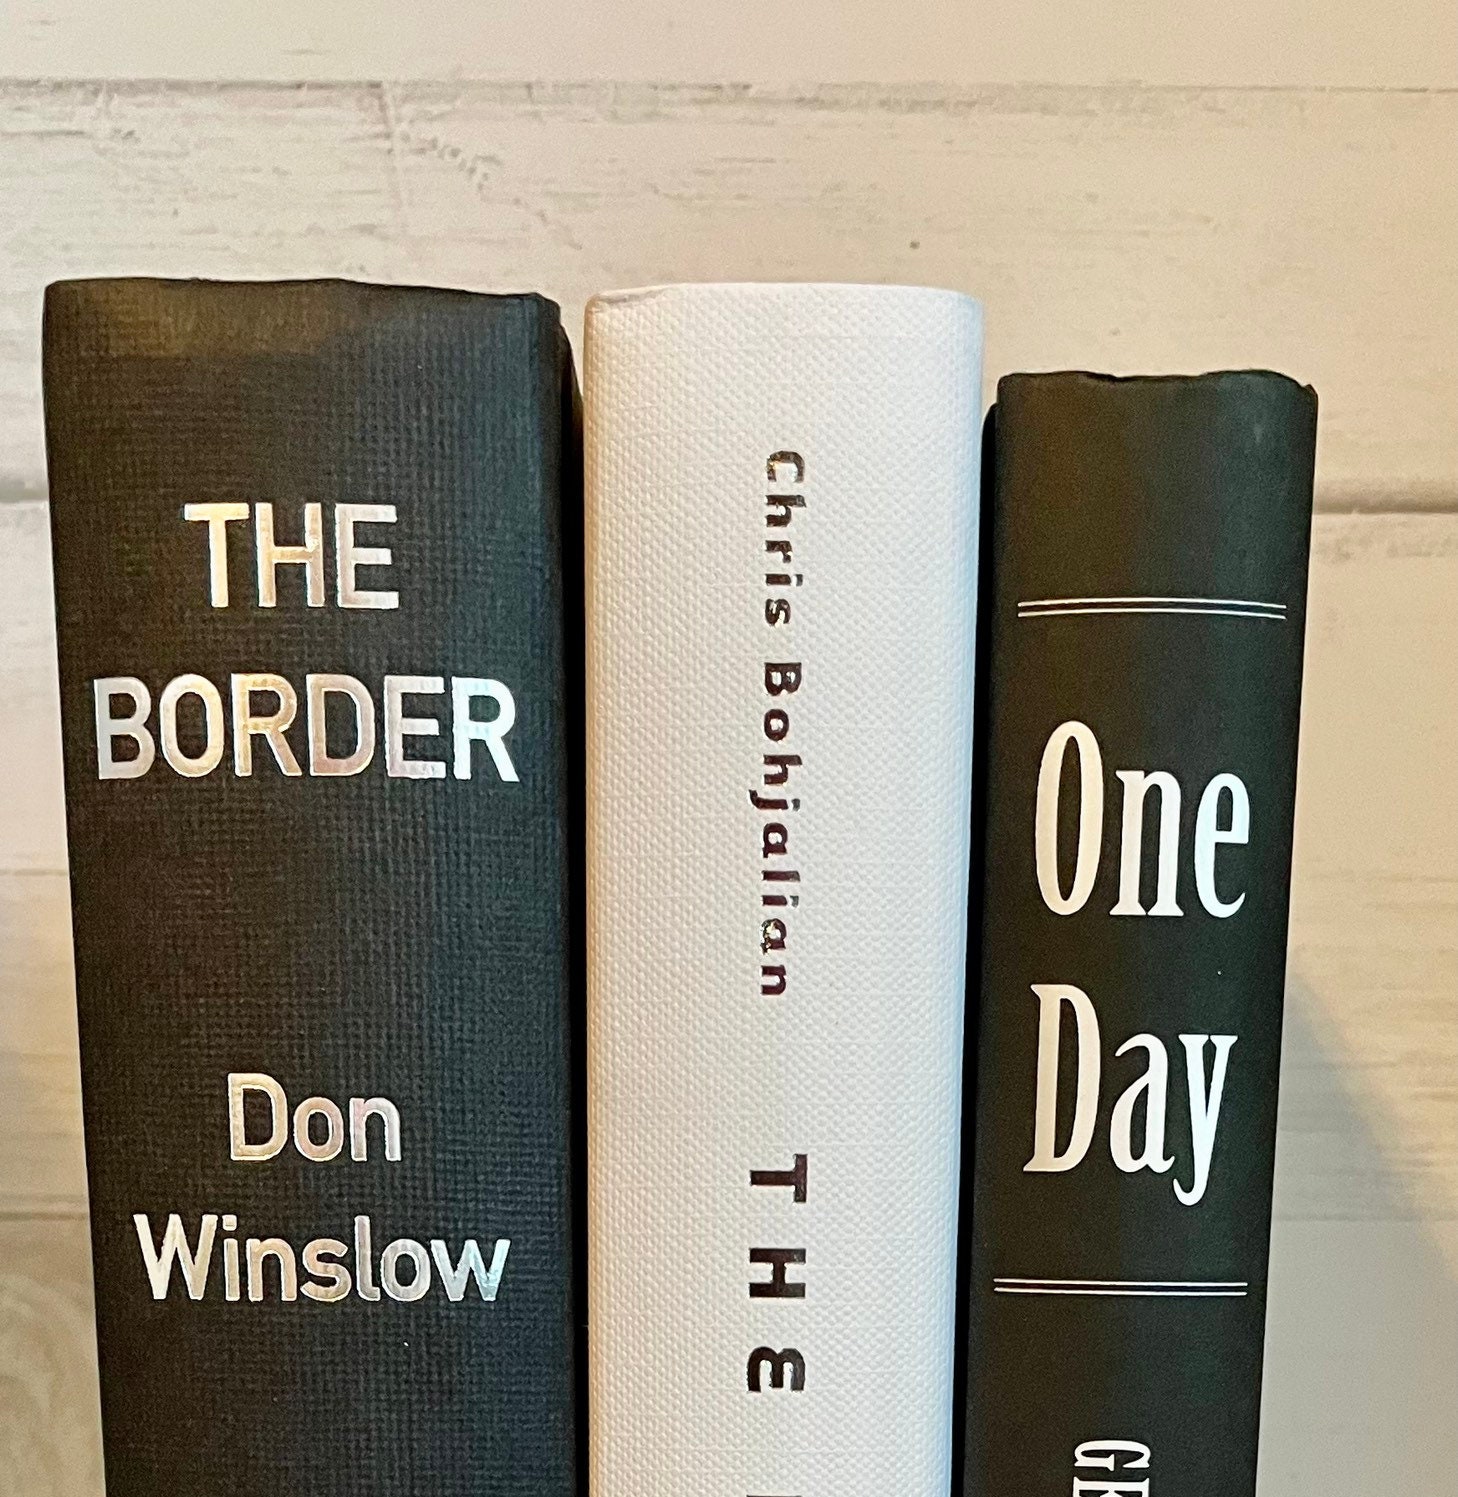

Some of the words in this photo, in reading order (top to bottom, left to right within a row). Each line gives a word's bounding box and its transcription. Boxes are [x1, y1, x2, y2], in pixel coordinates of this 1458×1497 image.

[183, 502, 400, 610] THE
[764, 449, 807, 628] Chris
[92, 673, 520, 783] BORDER
[748, 661, 804, 997] Bohjalian
[1033, 720, 1251, 919] One
[227, 1072, 402, 1162] Don
[1022, 983, 1239, 1207] Day
[133, 1212, 512, 1303] Winslow
[746, 1152, 809, 1394] THE
